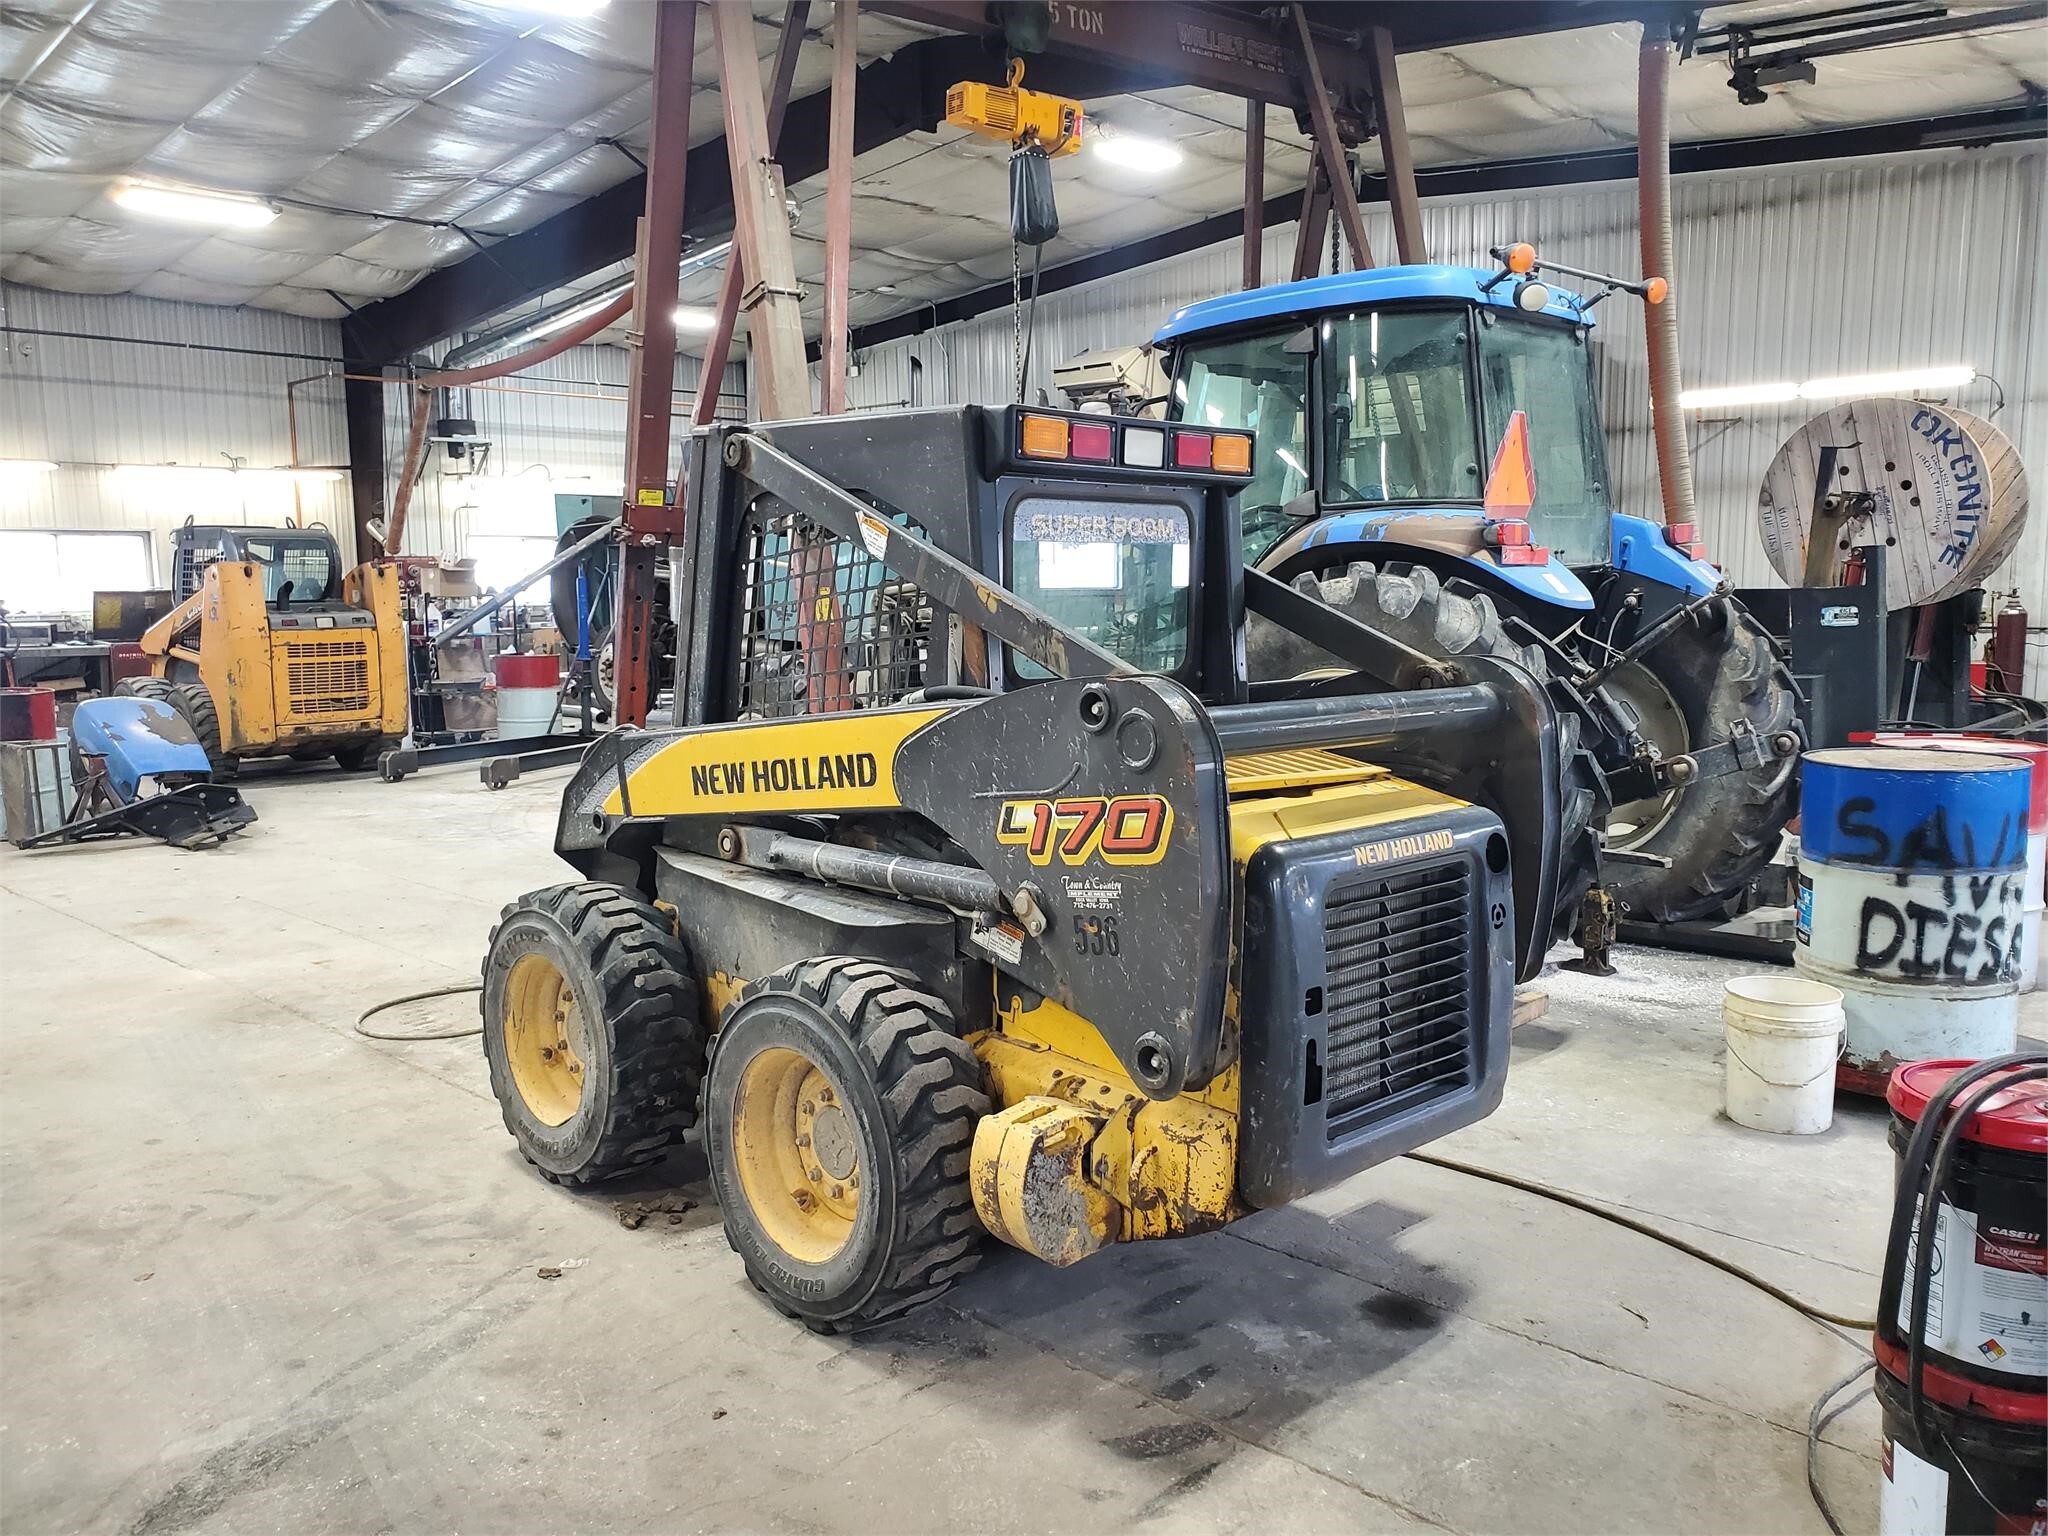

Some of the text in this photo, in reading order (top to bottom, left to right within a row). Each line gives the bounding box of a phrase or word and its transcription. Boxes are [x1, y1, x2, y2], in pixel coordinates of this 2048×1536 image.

[1066, 5, 1104, 35] TON
[1910, 410, 1982, 569] OKONITE
[1932, 480, 1944, 504] THIS
[1031, 514, 1174, 538] SUPER BOOM
[691, 752, 878, 796] NEW HOLLAND
[998, 796, 1173, 862] L170
[1354, 831, 1453, 866] NEW HOLLAND
[1060, 875, 1122, 894] Town & Country
[1989, 1226, 2027, 1239] CASE
